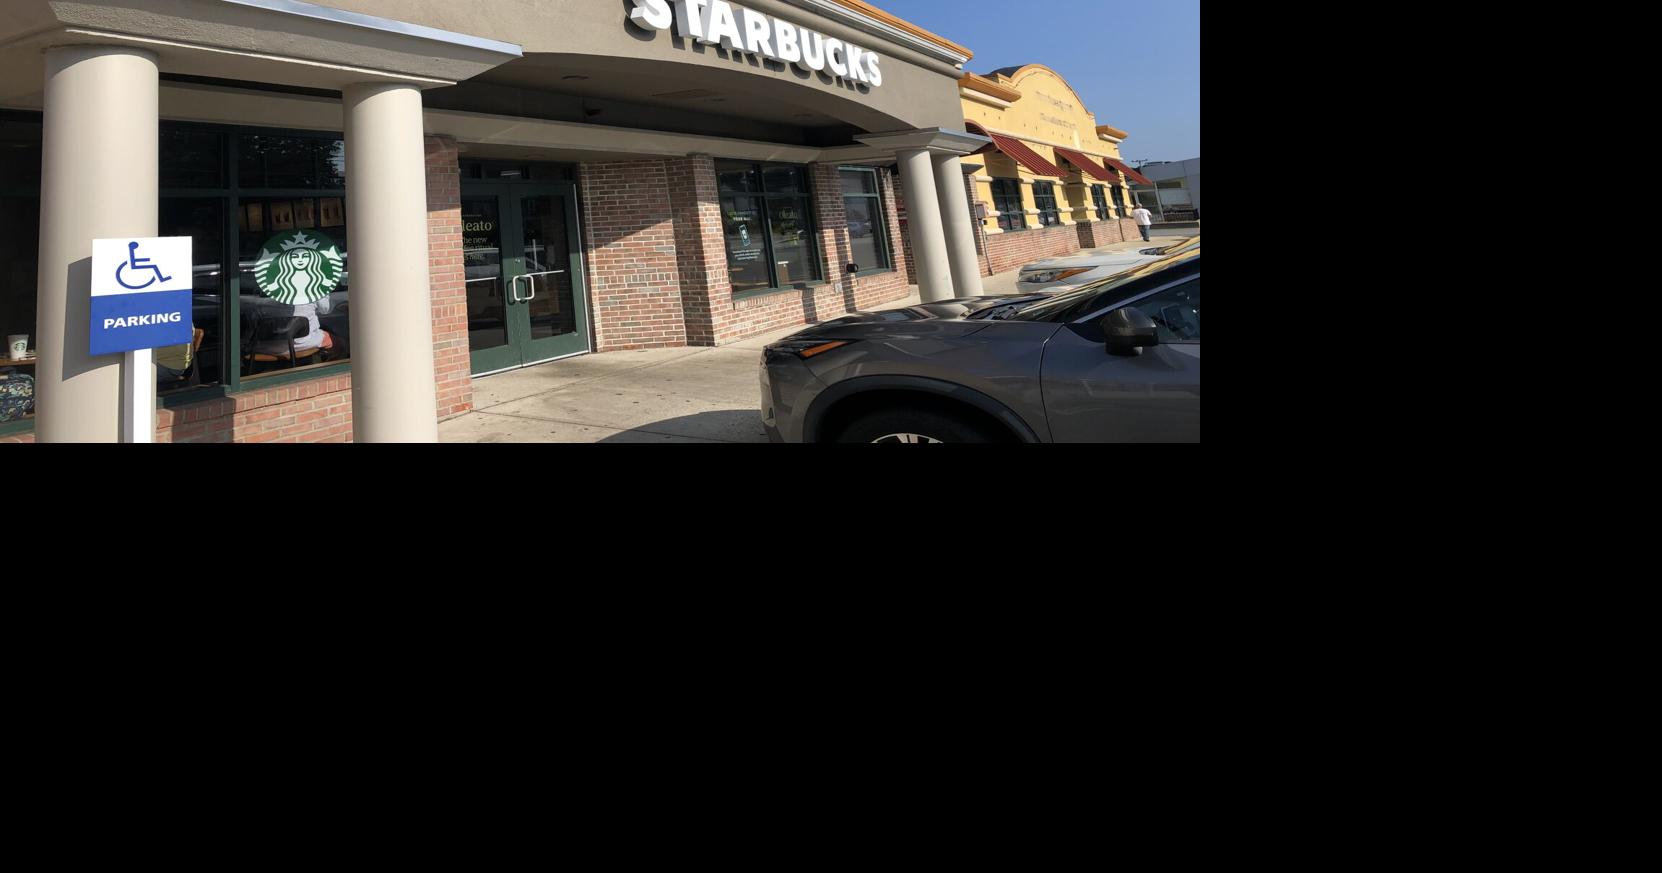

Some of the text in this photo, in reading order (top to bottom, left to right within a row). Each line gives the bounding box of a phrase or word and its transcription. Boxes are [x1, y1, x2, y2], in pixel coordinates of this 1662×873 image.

[631, 0, 882, 88] STARBUCKS
[462, 220, 492, 231] leato
[103, 311, 182, 330] PARKING
